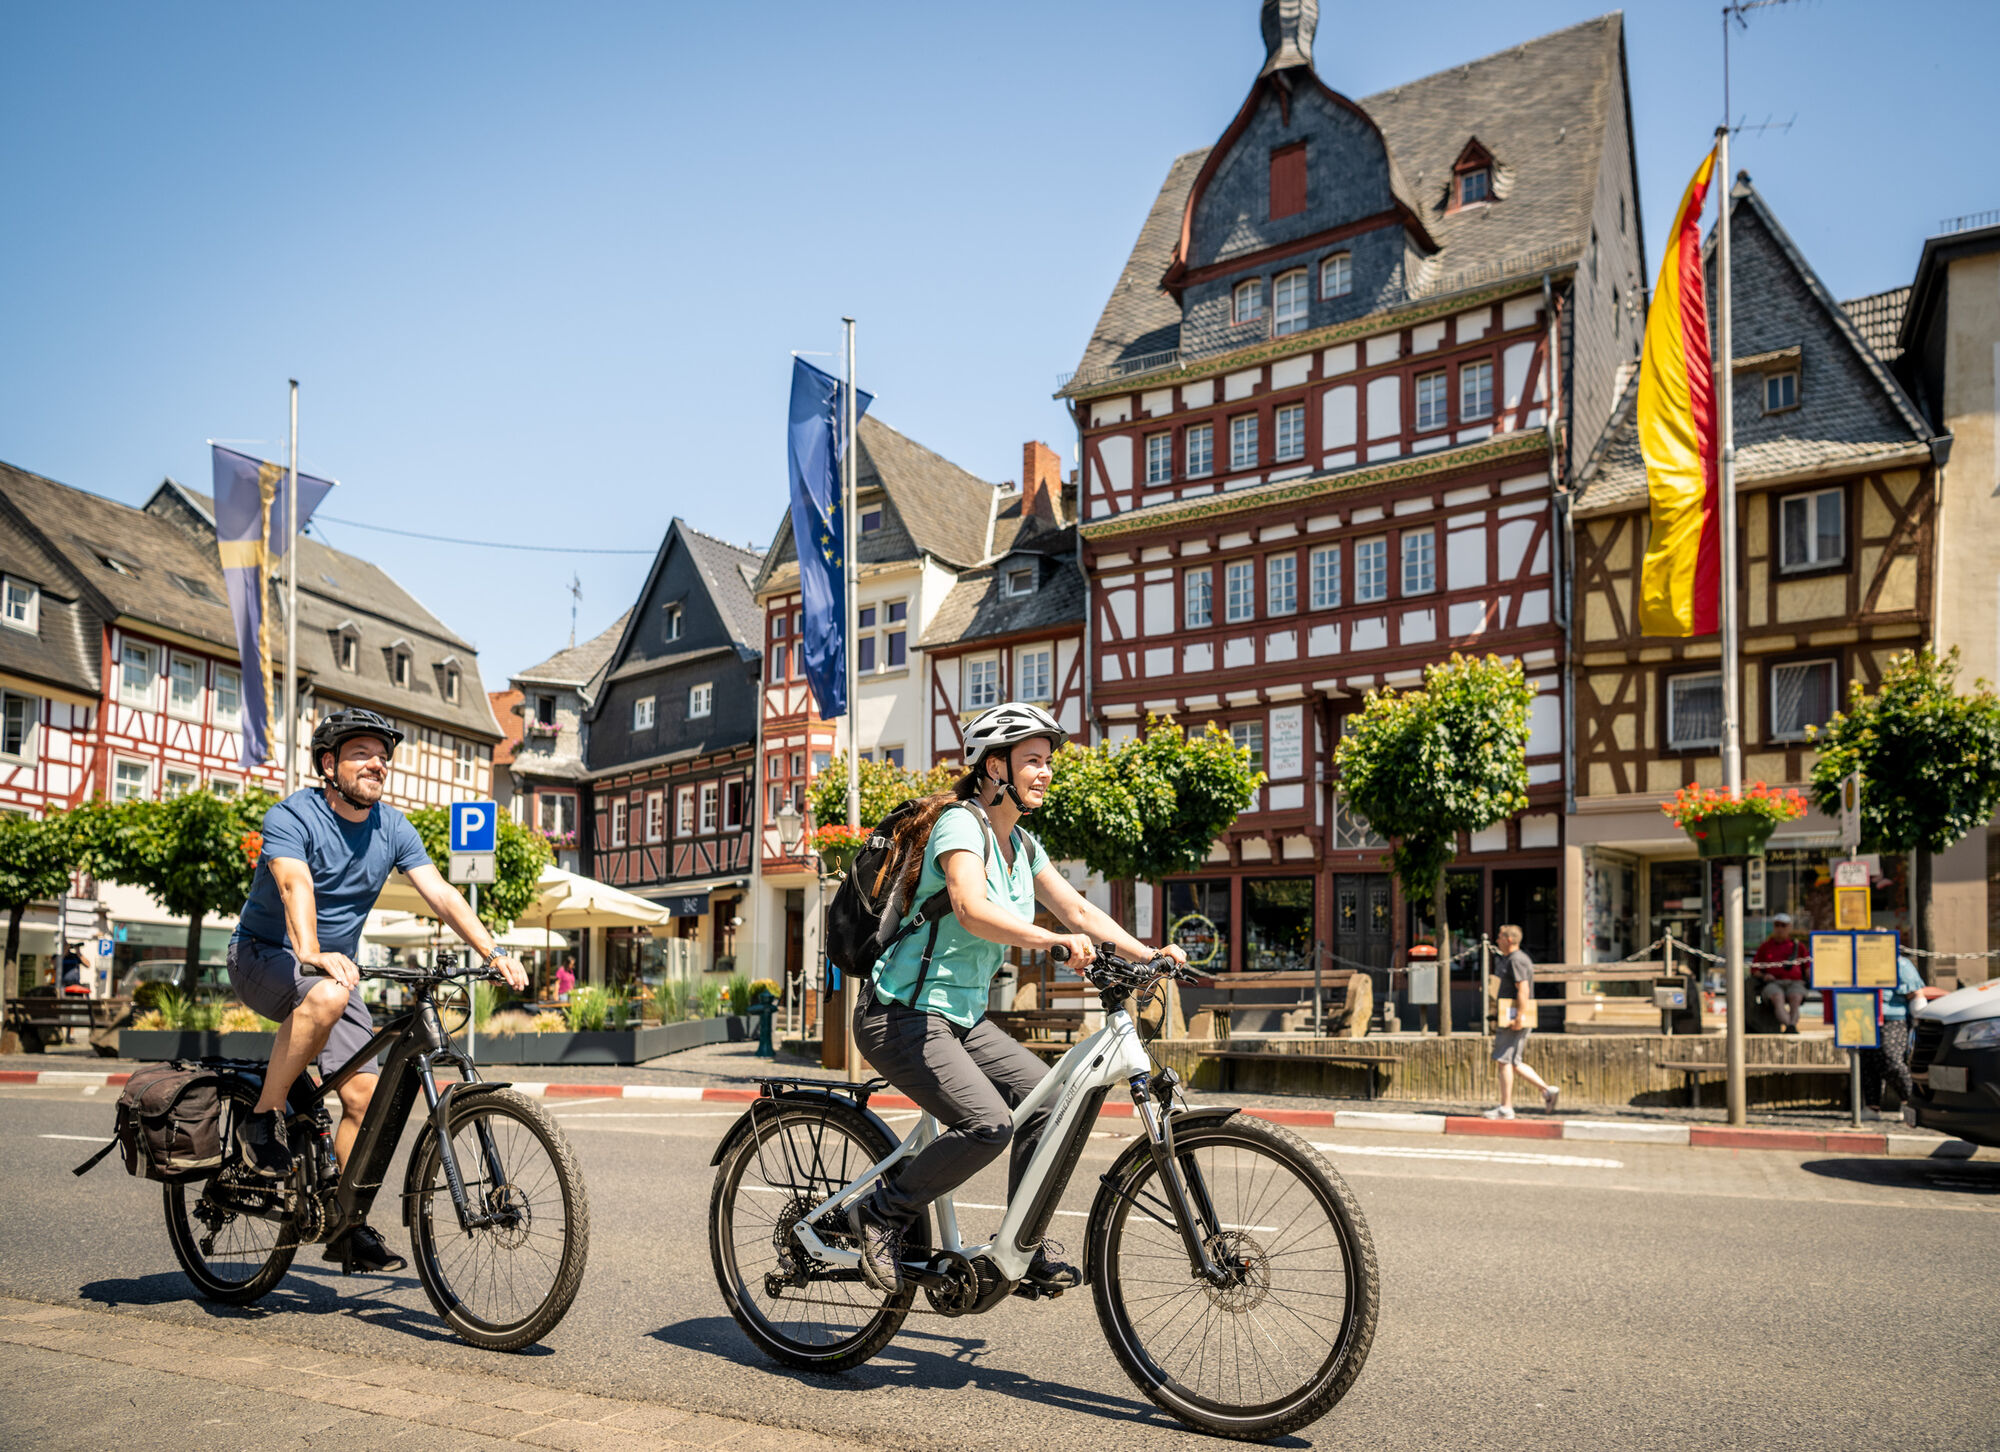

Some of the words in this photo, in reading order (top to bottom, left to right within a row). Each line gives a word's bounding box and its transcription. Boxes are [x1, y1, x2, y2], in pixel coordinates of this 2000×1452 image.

[461, 807, 485, 846] P
[101, 941, 112, 957] P
[1310, 1345, 1350, 1402] CONTINENTAL
